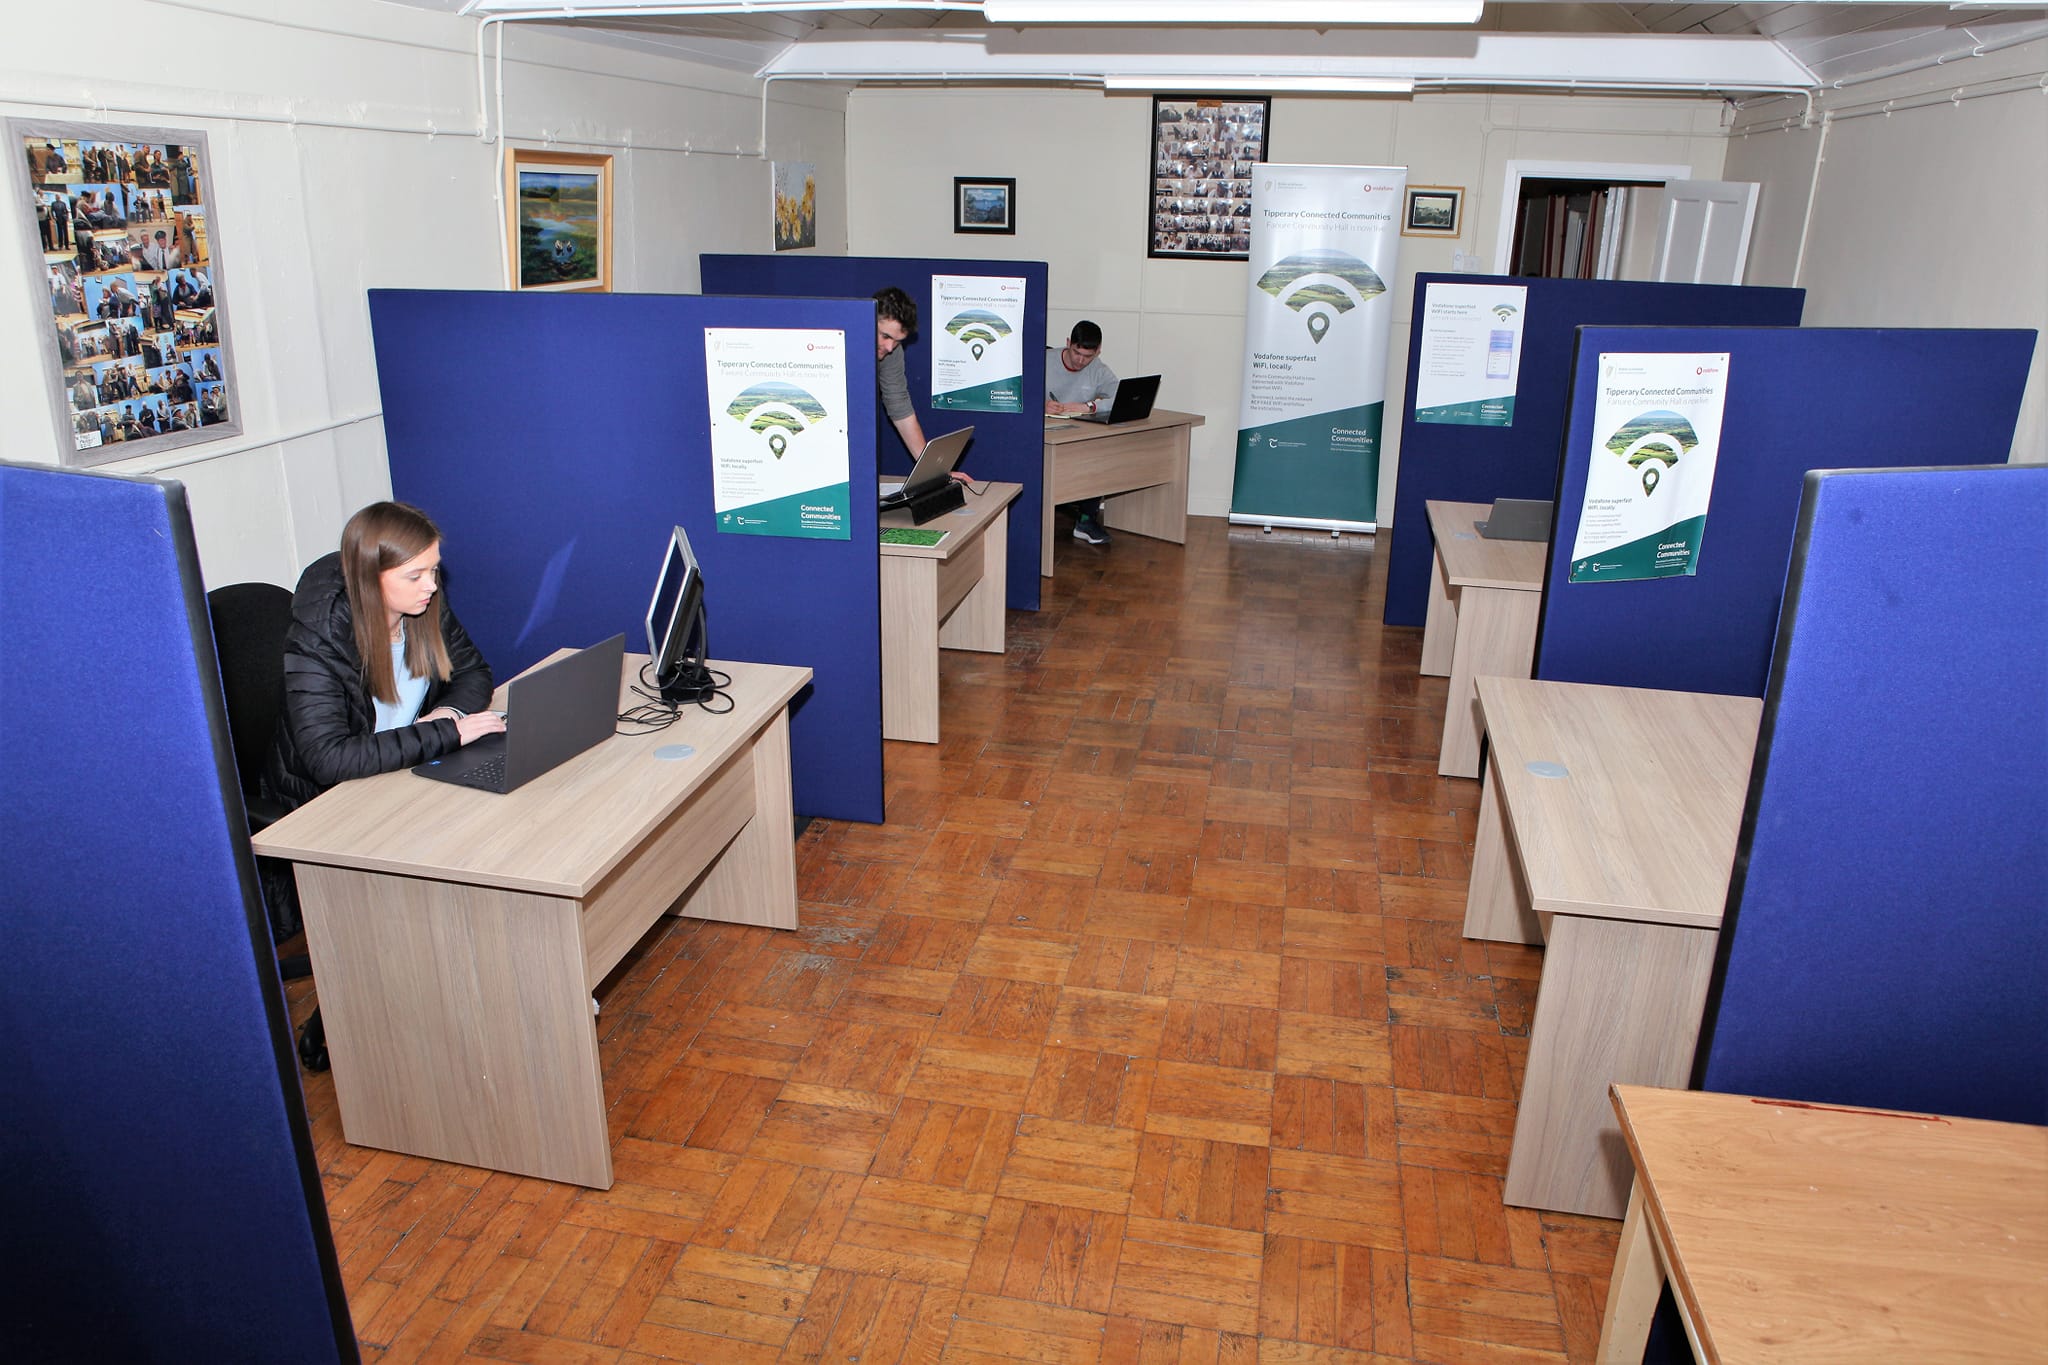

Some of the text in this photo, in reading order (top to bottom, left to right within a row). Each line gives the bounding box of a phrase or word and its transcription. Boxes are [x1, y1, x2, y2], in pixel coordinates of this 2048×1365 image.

[1263, 209, 1391, 221] Tipperary Connected Communities
[1285, 354, 1316, 362] superfast
[717, 360, 833, 370] Tipperary Connected Communities
[1606, 387, 1639, 396] Tipperary
[1676, 387, 1713, 395] Communities
[1331, 427, 1366, 436] Connected
[1331, 435, 1373, 444] Communities
[800, 504, 834, 512] Connected
[800, 512, 841, 521] Communities
[1658, 541, 1686, 550] Connected
[1656, 549, 1690, 559] Communities
